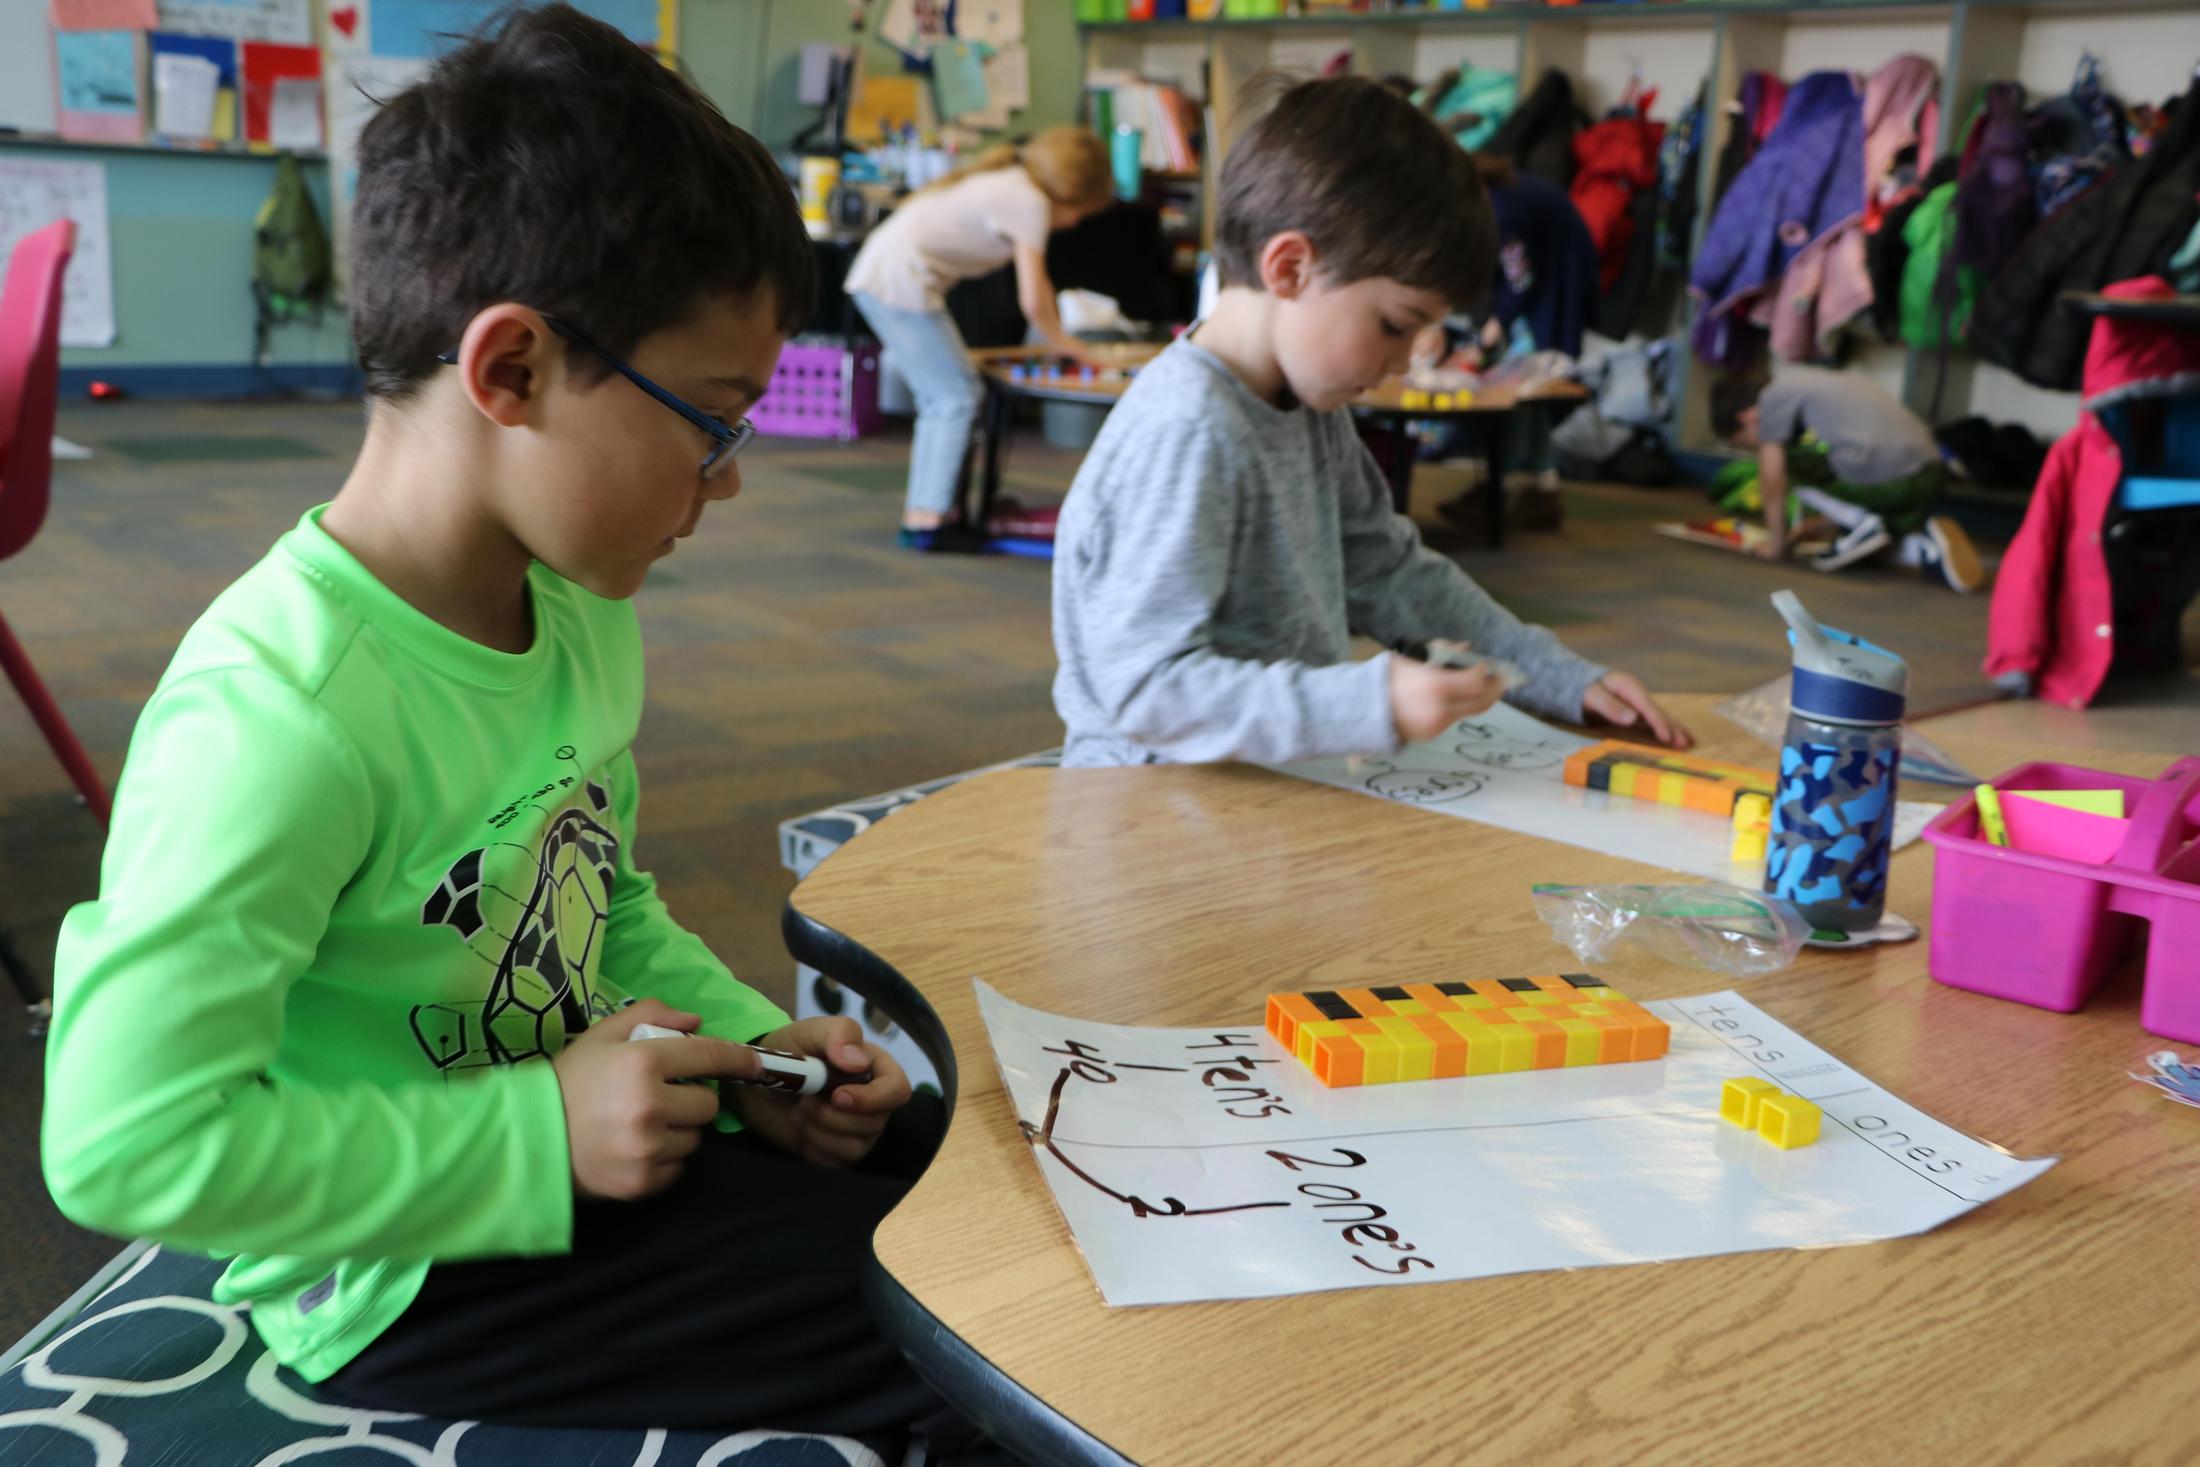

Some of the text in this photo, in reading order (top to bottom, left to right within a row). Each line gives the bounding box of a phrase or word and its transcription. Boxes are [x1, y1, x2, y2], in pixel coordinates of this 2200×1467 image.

[1185, 1033, 1259, 1049] 4
[1696, 1005, 1786, 1064] tens
[1042, 1039, 1117, 1084] 40
[1264, 1148, 1367, 1171] 2
[1853, 1114, 1963, 1174] ones
[1124, 1196, 1187, 1218] 2
